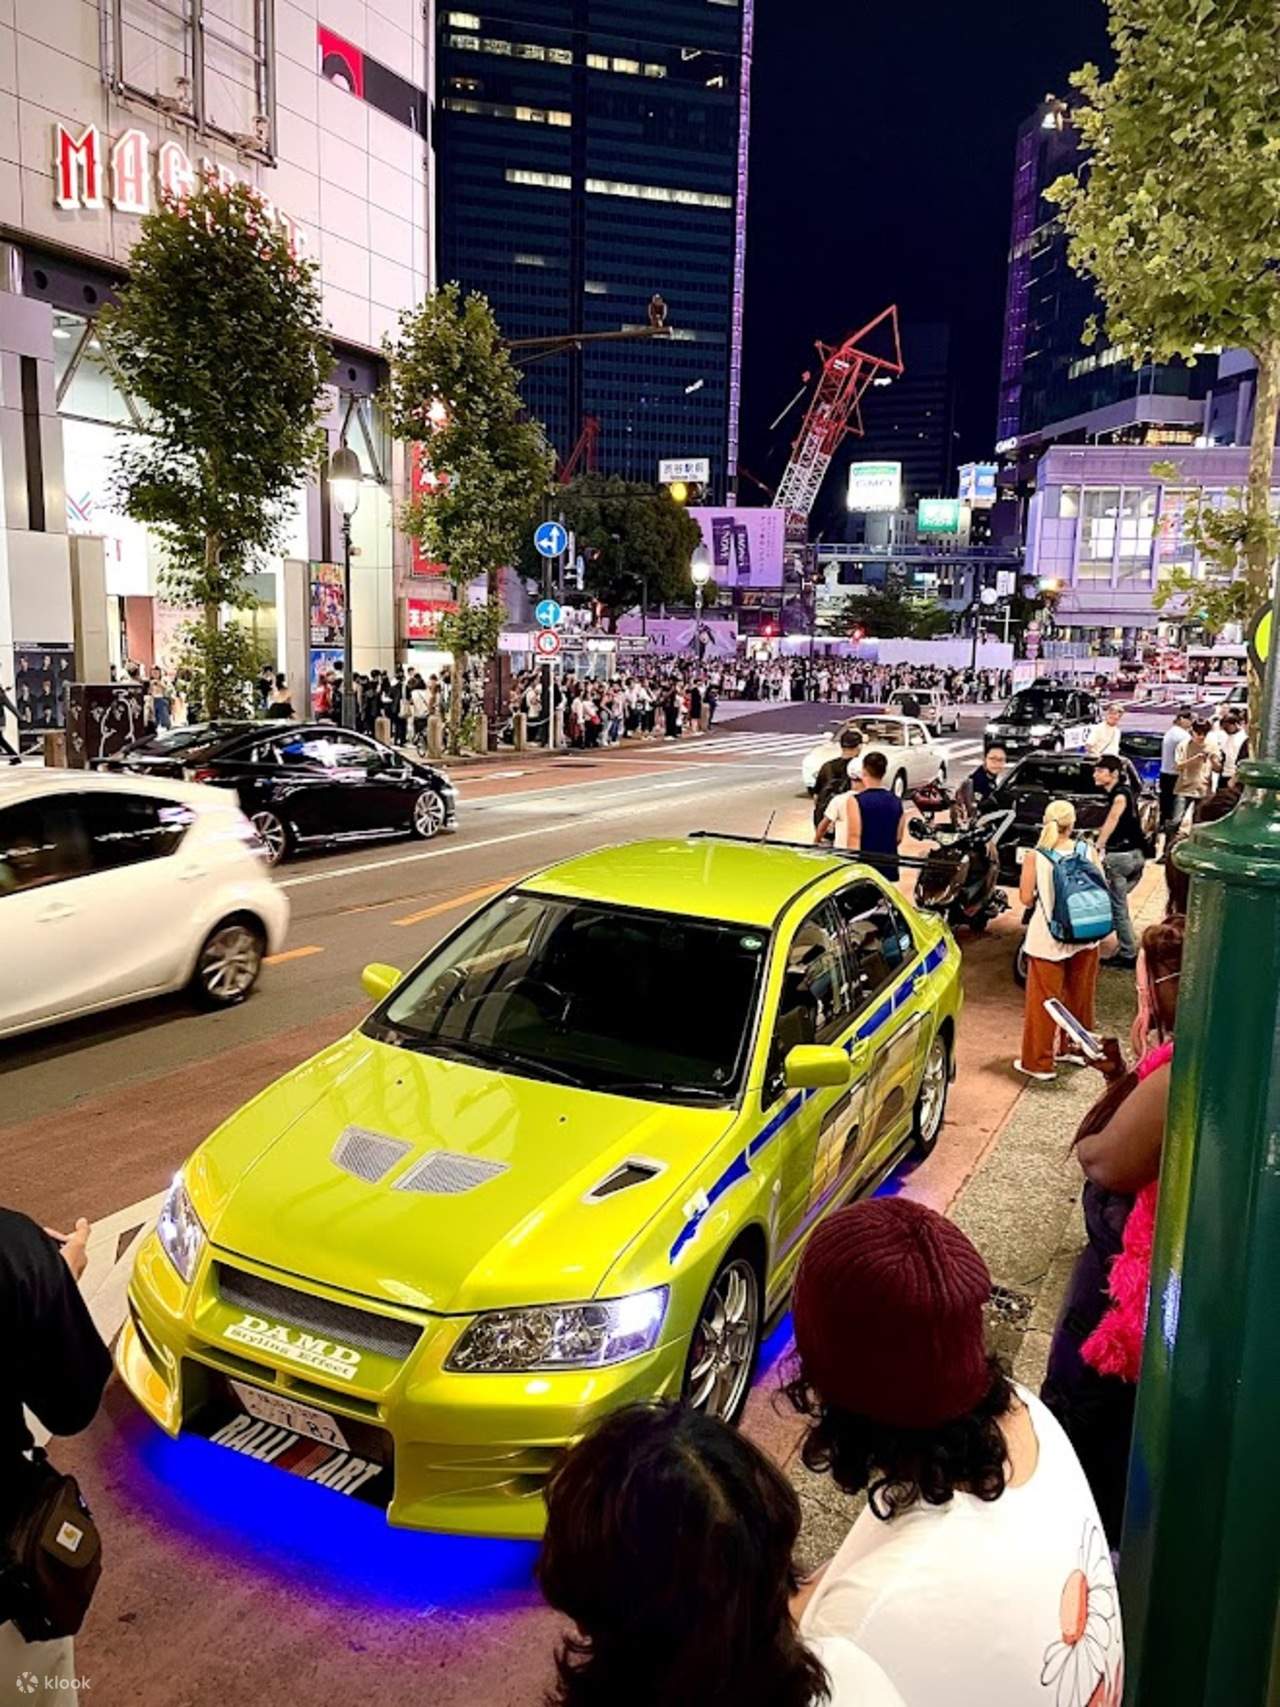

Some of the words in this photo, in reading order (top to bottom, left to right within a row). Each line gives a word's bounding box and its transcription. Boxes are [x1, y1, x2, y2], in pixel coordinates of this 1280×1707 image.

[238, 1315, 361, 1365] DAMD
[209, 1413, 300, 1464] RALLI
[306, 1451, 383, 1497] ART
